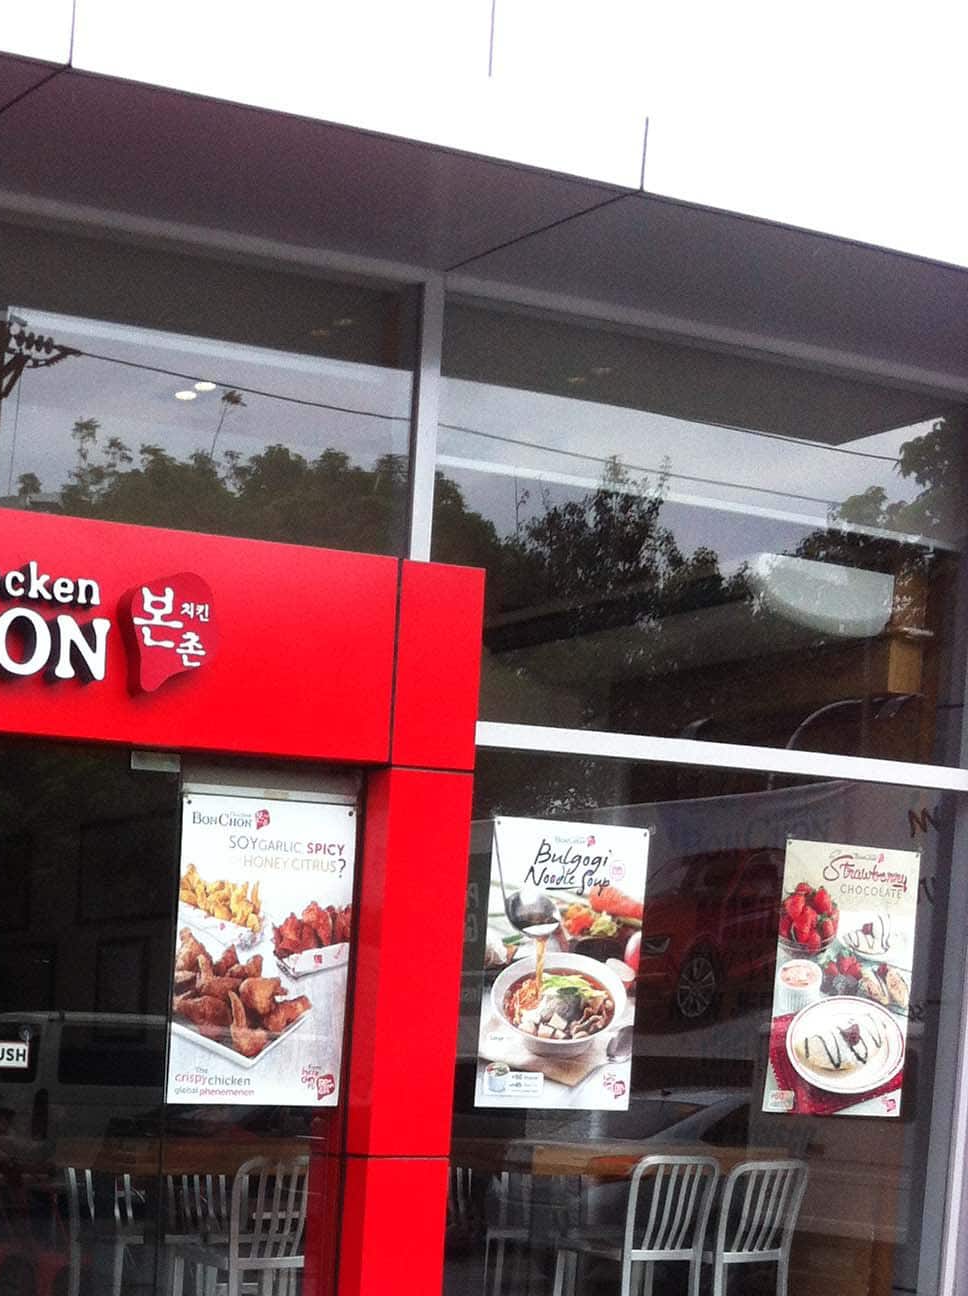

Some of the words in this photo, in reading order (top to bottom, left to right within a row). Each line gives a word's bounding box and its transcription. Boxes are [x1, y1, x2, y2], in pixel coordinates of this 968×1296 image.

[307, 842, 345, 856] SPICY
[534, 838, 612, 876] Bulgogi
[524, 865, 575, 887] Noodle
[576, 869, 611, 896] Soup
[823, 855, 907, 892] Strawberry
[840, 884, 903, 899] CHOCOLATE
